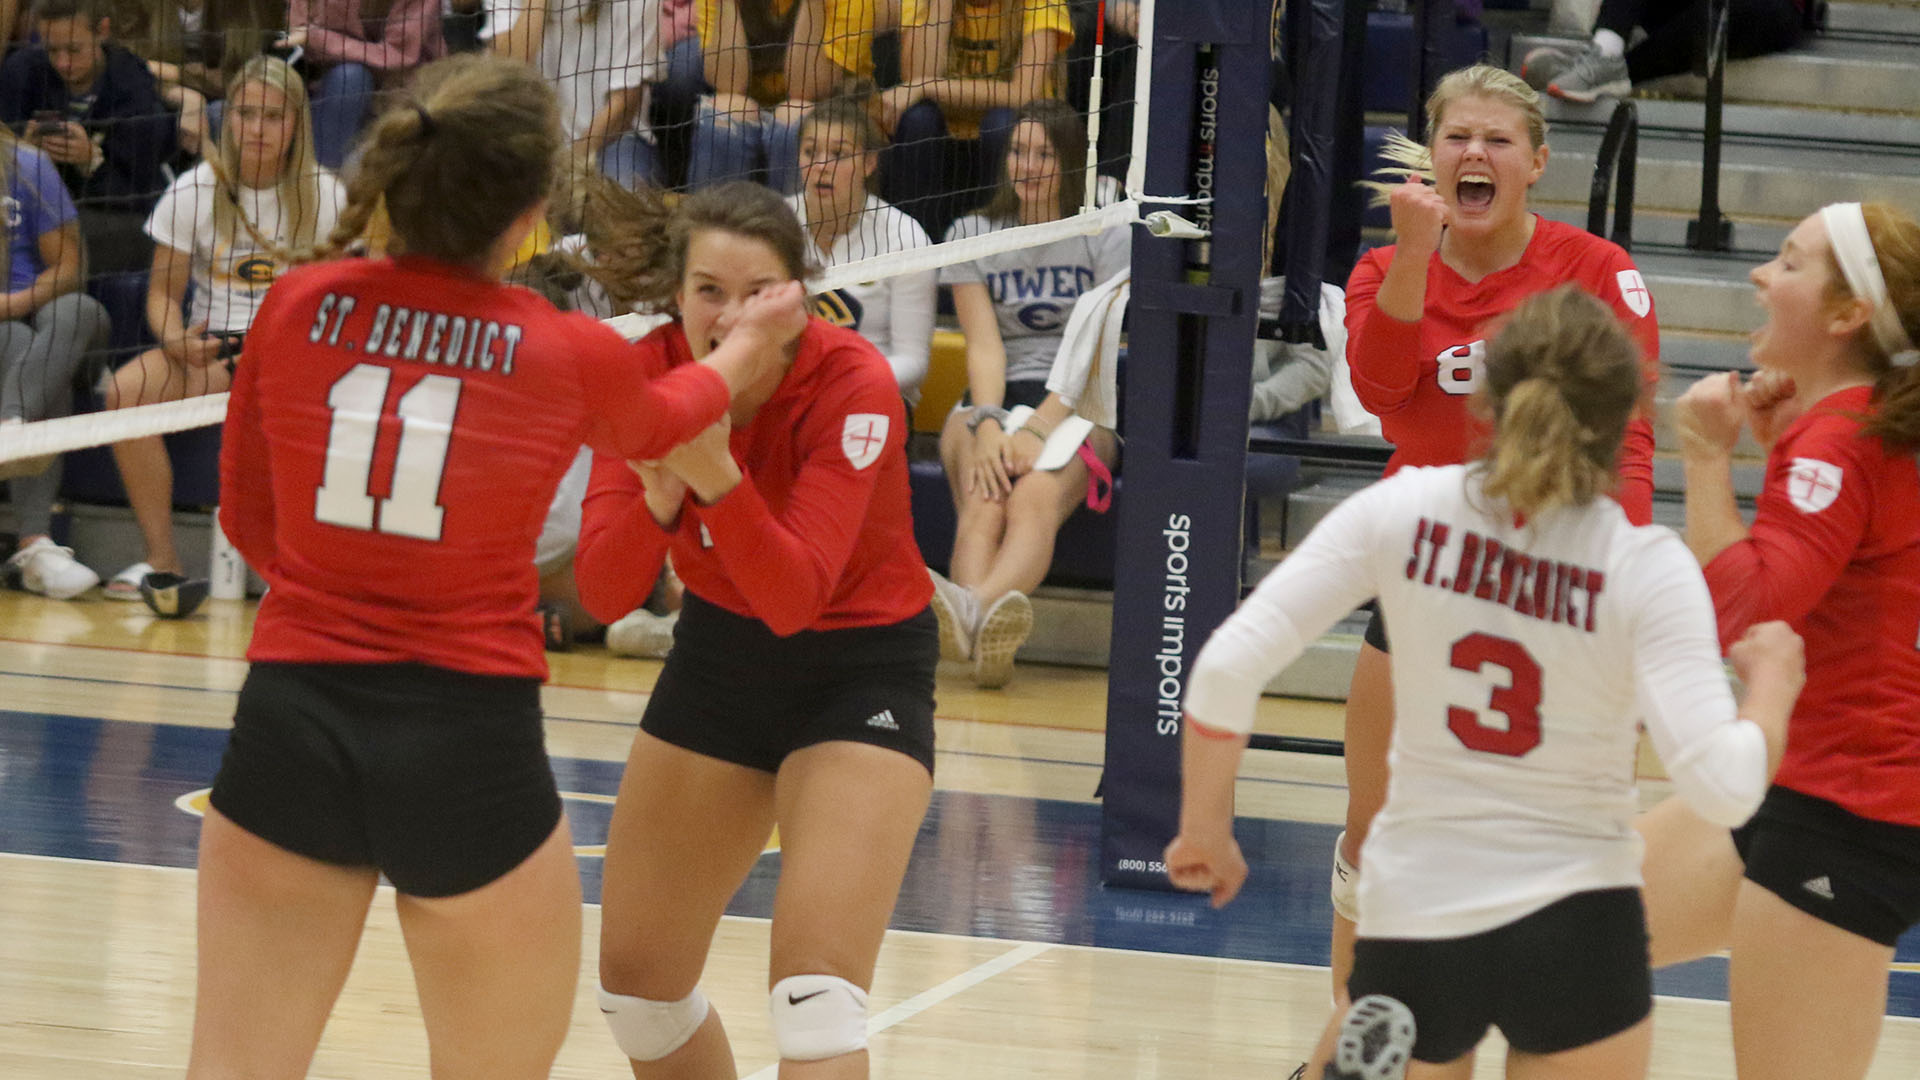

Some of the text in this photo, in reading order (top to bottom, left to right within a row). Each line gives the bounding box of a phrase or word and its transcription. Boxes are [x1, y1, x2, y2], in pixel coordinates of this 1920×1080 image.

[1200, 68, 1219, 140] sports
[309, 292, 522, 375] ST. BENEDICT
[1435, 339, 1487, 396] 8
[314, 362, 463, 543] 11
[1155, 513, 1191, 736] sports imports
[1446, 631, 1544, 758] 3
[1118, 859, 1146, 872] (800)
